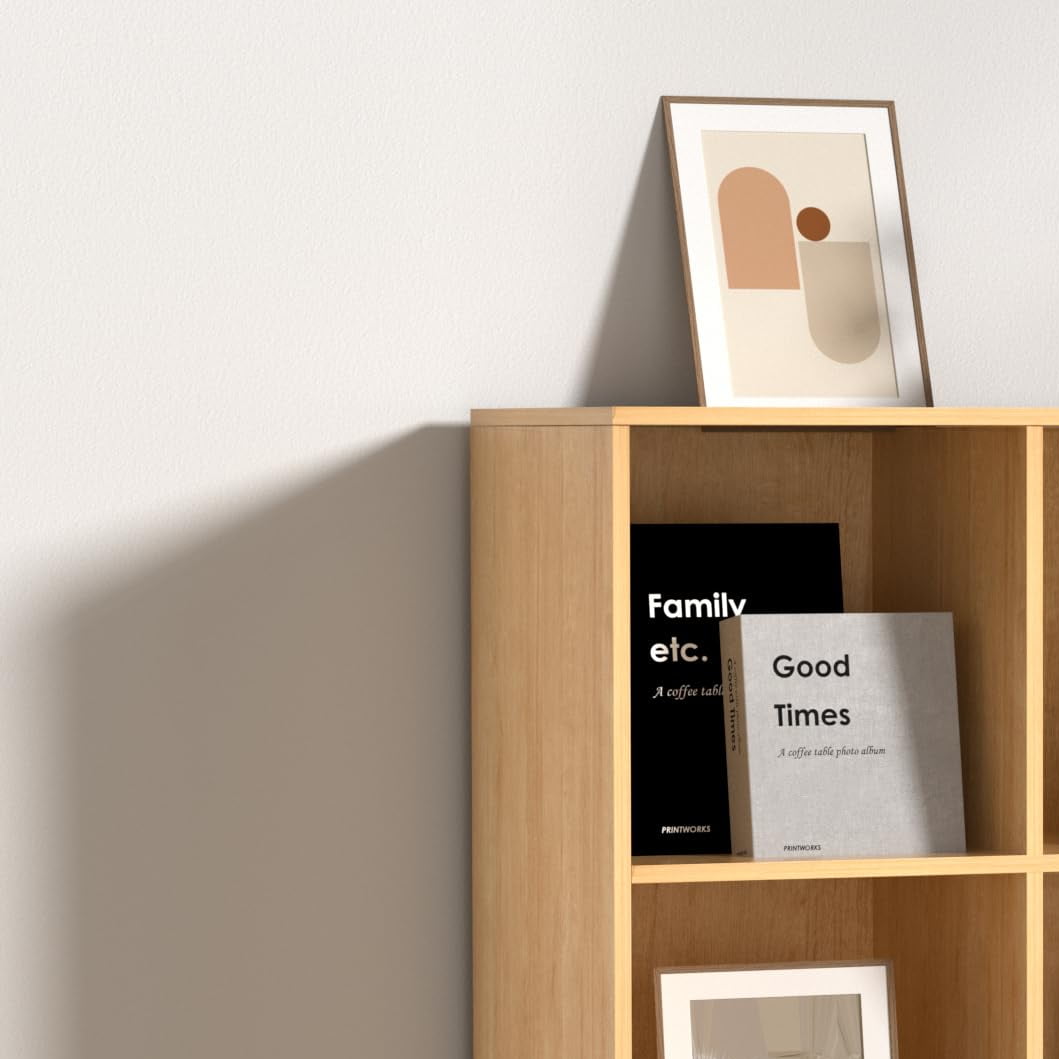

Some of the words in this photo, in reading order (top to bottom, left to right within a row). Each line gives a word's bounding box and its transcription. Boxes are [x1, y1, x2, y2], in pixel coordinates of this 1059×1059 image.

[648, 592, 747, 618] Family
[650, 637, 708, 662] etc.
[773, 654, 850, 678] Good
[652, 686, 663, 699] A
[667, 684, 698, 700] coffee
[774, 704, 851, 726] Times
[777, 748, 786, 758] A
[788, 747, 812, 759] coffee
[814, 746, 834, 756] table
[836, 746, 859, 758] photo
[861, 745, 886, 755] album
[661, 825, 711, 834] PRINTWORKS
[783, 844, 822, 852] PRINTWORKS
